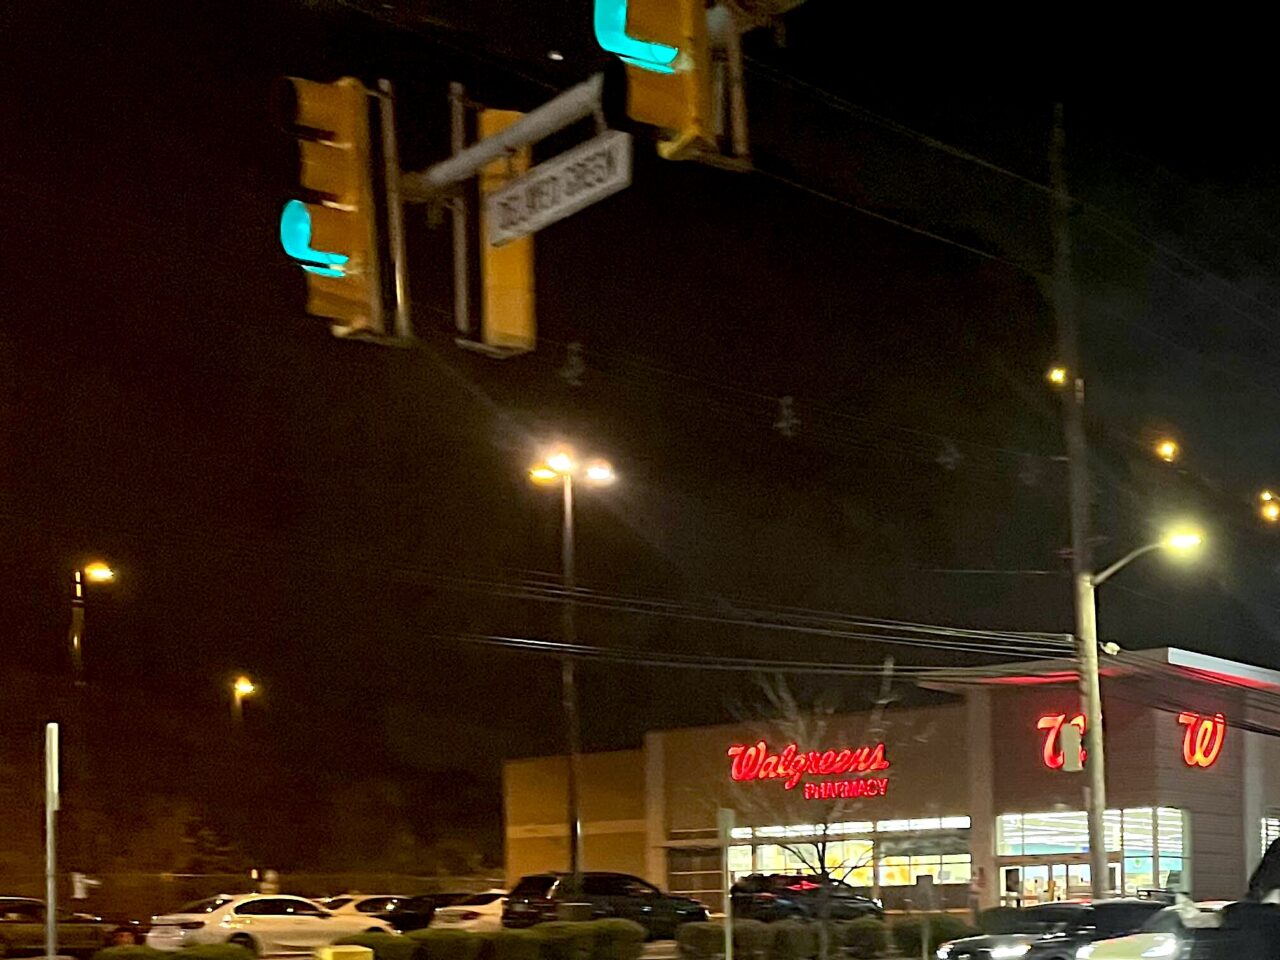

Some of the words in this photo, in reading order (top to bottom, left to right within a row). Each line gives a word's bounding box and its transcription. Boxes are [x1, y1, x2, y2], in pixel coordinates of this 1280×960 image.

[1178, 711, 1225, 768] W
[727, 740, 890, 790] Walgreens
[804, 778, 889, 800] PHARMACY
